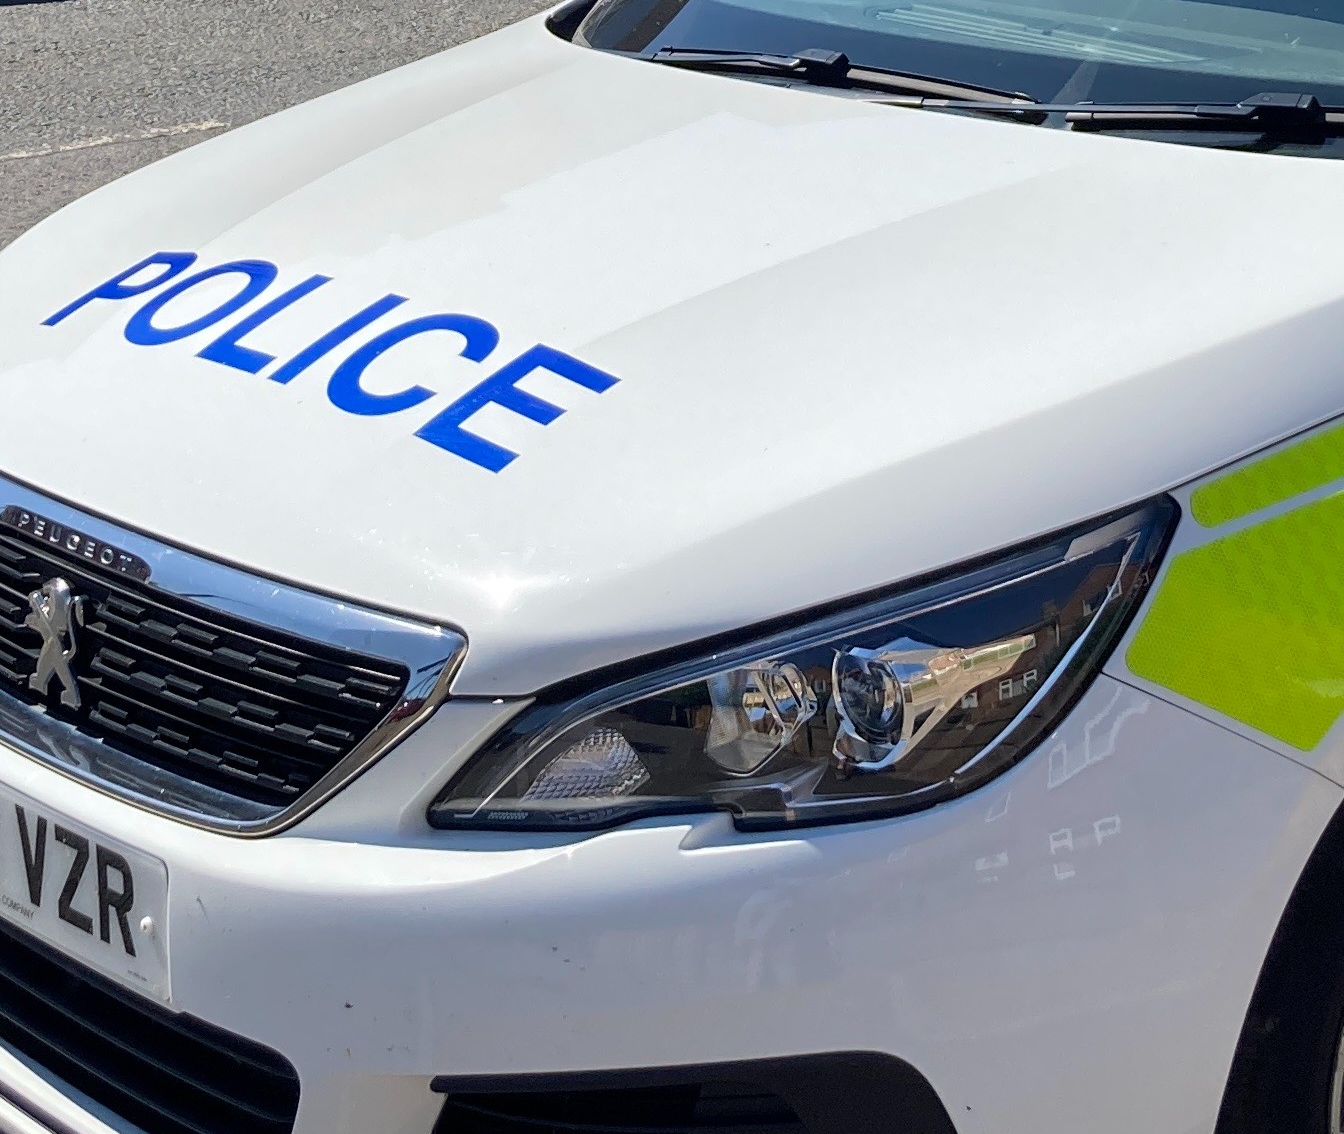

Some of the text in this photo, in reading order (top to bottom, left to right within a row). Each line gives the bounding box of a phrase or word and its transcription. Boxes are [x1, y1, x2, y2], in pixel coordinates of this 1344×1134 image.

[39, 250, 623, 475] POLICE
[17, 512, 133, 572] PEUGEOT
[14, 801, 138, 958] VZR
